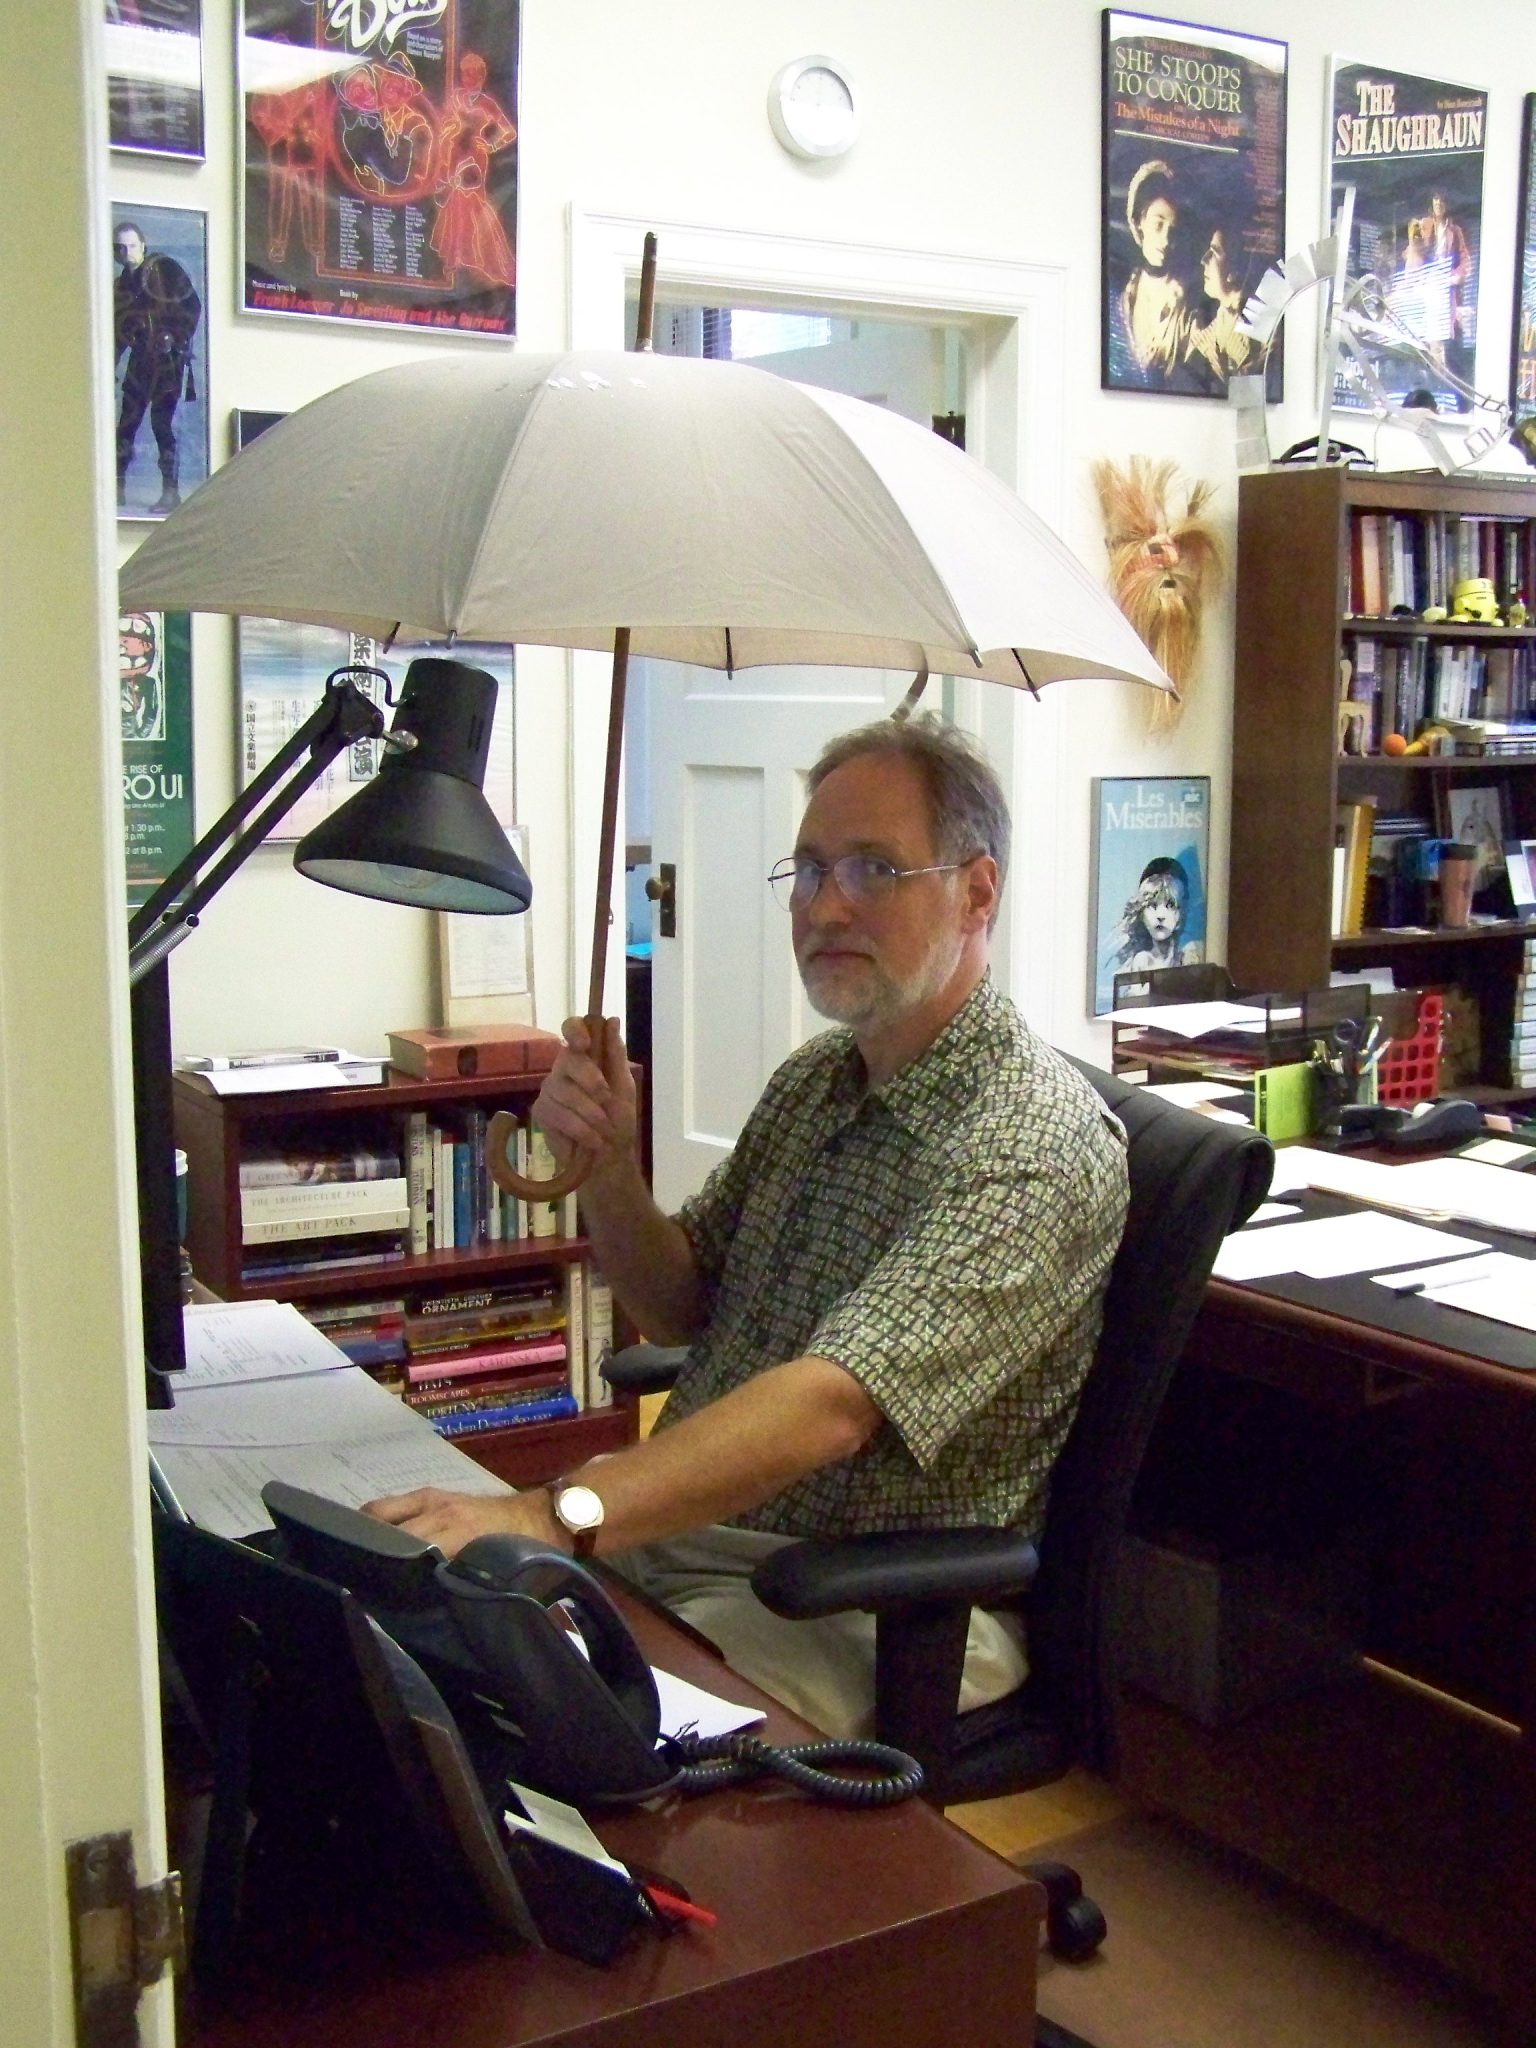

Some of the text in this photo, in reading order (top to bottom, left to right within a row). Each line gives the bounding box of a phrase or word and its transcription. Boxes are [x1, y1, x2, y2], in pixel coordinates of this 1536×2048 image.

[1115, 46, 1241, 90] SHE STOOPS
[1114, 71, 1242, 114] TO CONQUER
[1356, 80, 1395, 117] THE
[1115, 101, 1137, 120] The
[1137, 107, 1187, 128] Mistakes
[1188, 115, 1200, 130] of
[1208, 118, 1241, 139] Night
[1335, 111, 1483, 157] SHAUGHRAUN
[130, 765, 148, 774] RISE
[150, 764, 163, 774] OF
[161, 774, 183, 800] UI
[1137, 784, 1165, 808] Les
[131, 847, 140, 855] at
[140, 847, 146, 855] 8
[262, 1216, 357, 1235] THE ART PACK
[422, 1297, 492, 1315] ORNAMENT
[411, 1388, 470, 1405] ROOMSCAPES
